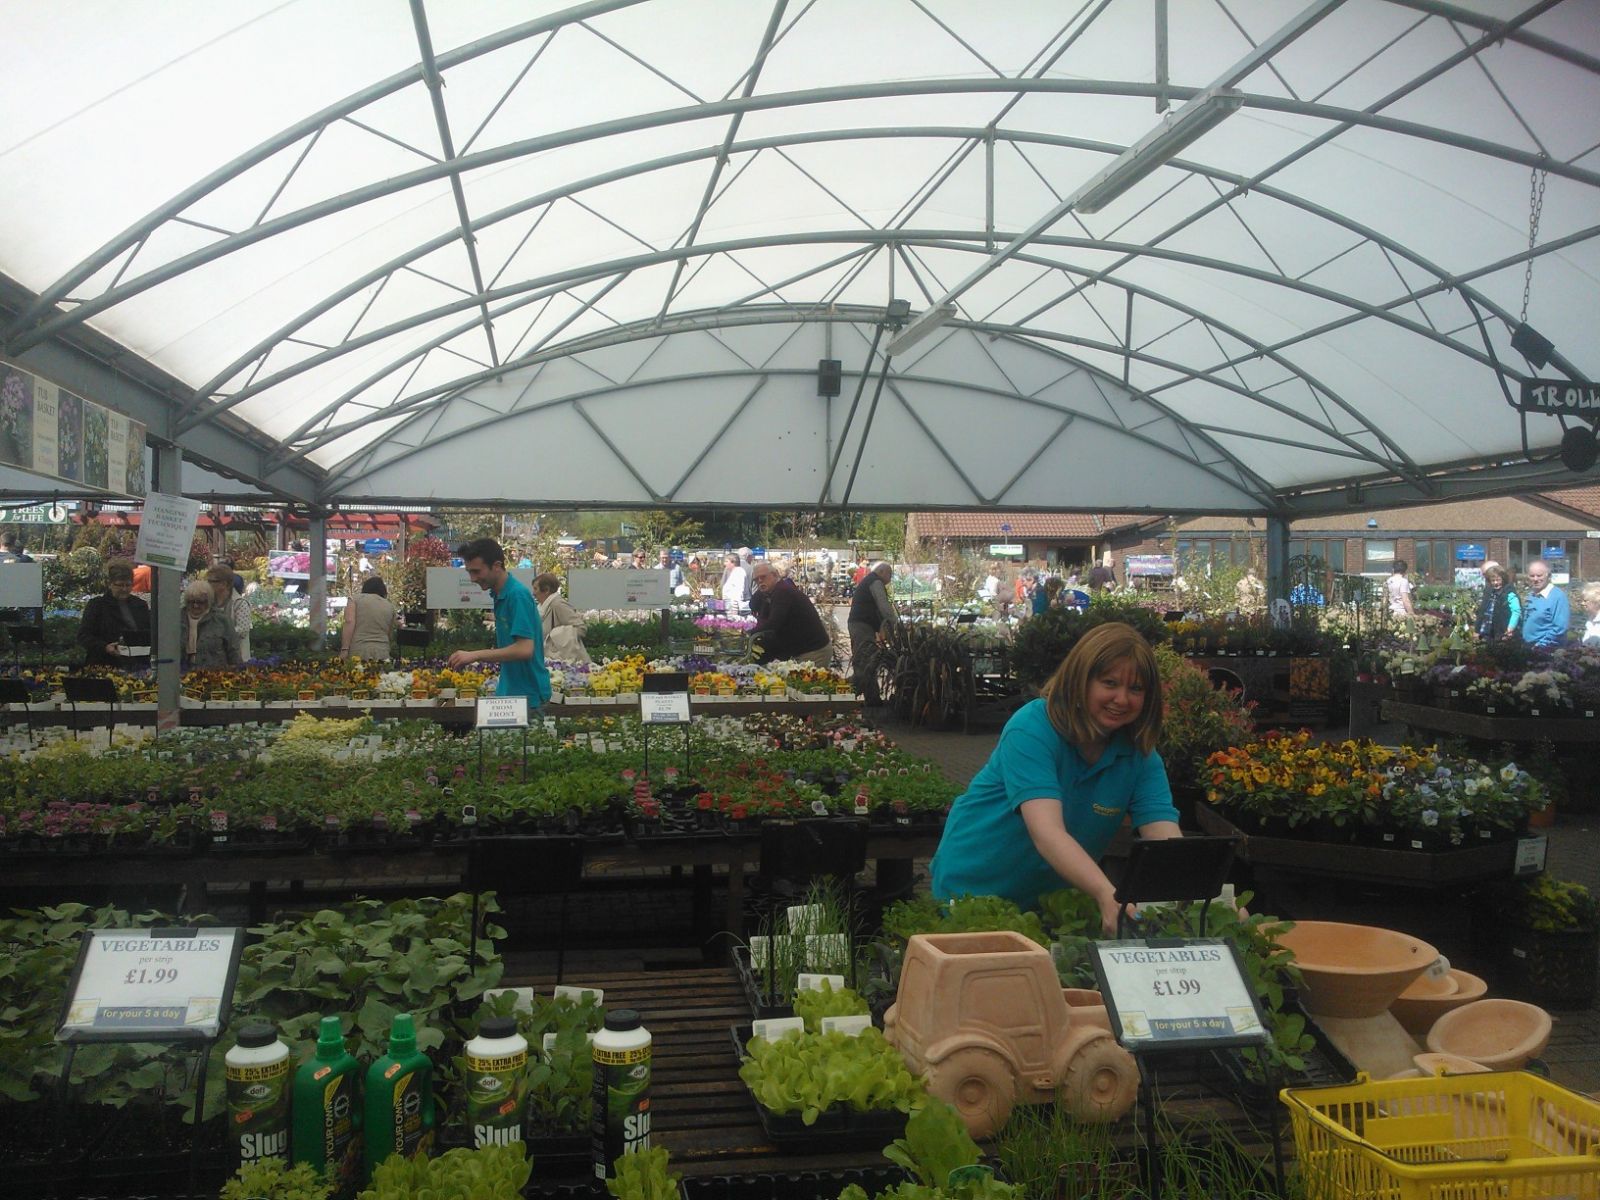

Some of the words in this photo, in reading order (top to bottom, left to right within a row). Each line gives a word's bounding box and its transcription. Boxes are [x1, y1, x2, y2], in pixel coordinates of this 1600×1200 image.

[37, 401, 56, 416] BASKET
[22, 514, 44, 522] LIFE
[155, 514, 184, 524] BASKET
[101, 939, 221, 952] VEGETABLES
[154, 955, 174, 964] strip
[1109, 950, 1222, 964] VEGETABLES
[124, 968, 179, 984] £1.99
[1153, 979, 1201, 996] £1.99
[102, 1009, 118, 1018] for
[119, 1010, 143, 1019] your
[145, 1009, 151, 1017] 5
[162, 1009, 180, 1019] day
[1154, 1021, 1168, 1030] for
[1170, 1022, 1192, 1031] your
[1193, 1020, 1199, 1028] 5
[1209, 1019, 1225, 1029] day
[492, 1056, 511, 1066] EXTRA
[512, 1052, 524, 1063] FREE
[245, 1067, 260, 1076] 25%
[261, 1062, 280, 1074] EXTRA
[481, 1079, 497, 1087] doff
[250, 1086, 266, 1095] doff
[241, 1128, 288, 1158] Slug
[325, 1128, 335, 1157] YOUR
[395, 1125, 404, 1156] YOUR
[474, 1123, 521, 1149] Slug
